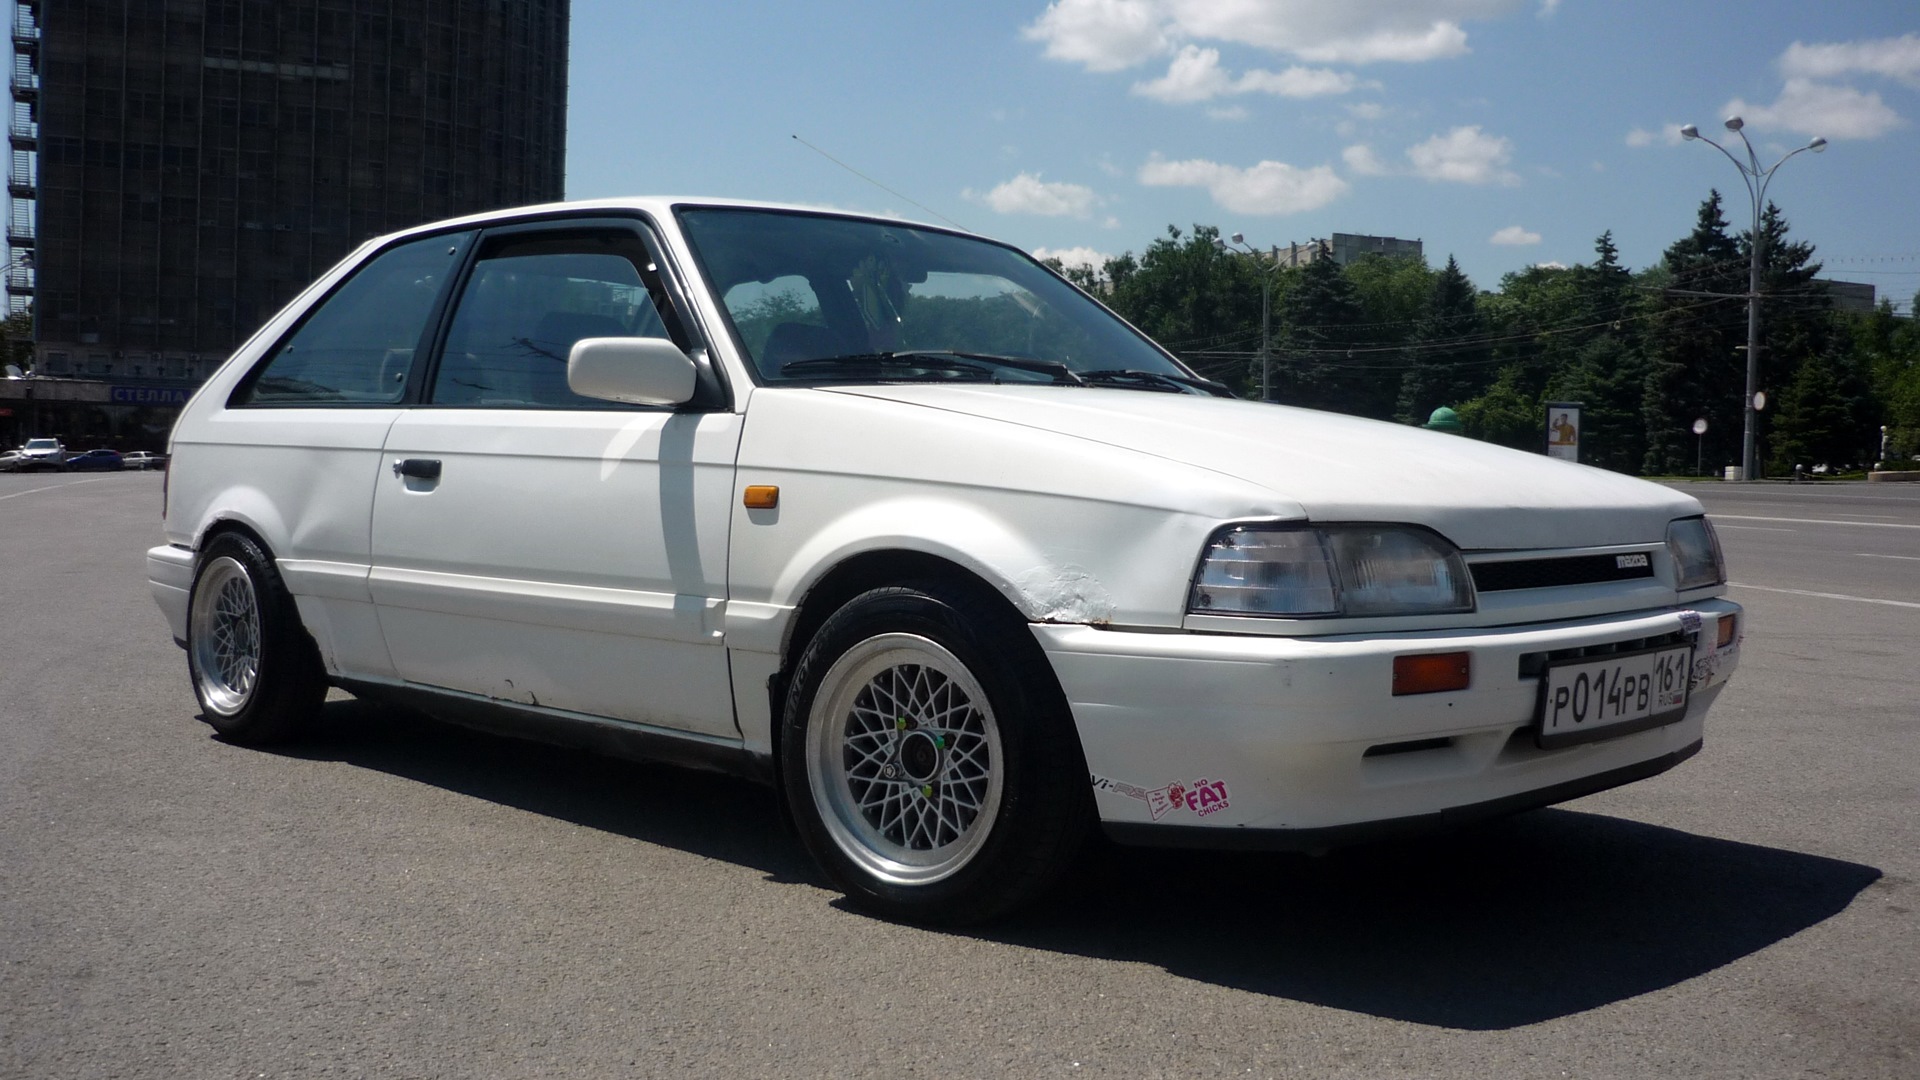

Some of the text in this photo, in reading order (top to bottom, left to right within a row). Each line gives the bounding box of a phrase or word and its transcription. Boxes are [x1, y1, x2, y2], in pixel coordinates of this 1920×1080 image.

[113, 388, 186, 402] СТЕЛЛА
[1655, 654, 1684, 692] 161
[1658, 694, 1673, 707] RUS
[1194, 779, 1208, 788] NO
[1185, 781, 1228, 811] FAT
[1198, 800, 1229, 817] CHICKS
